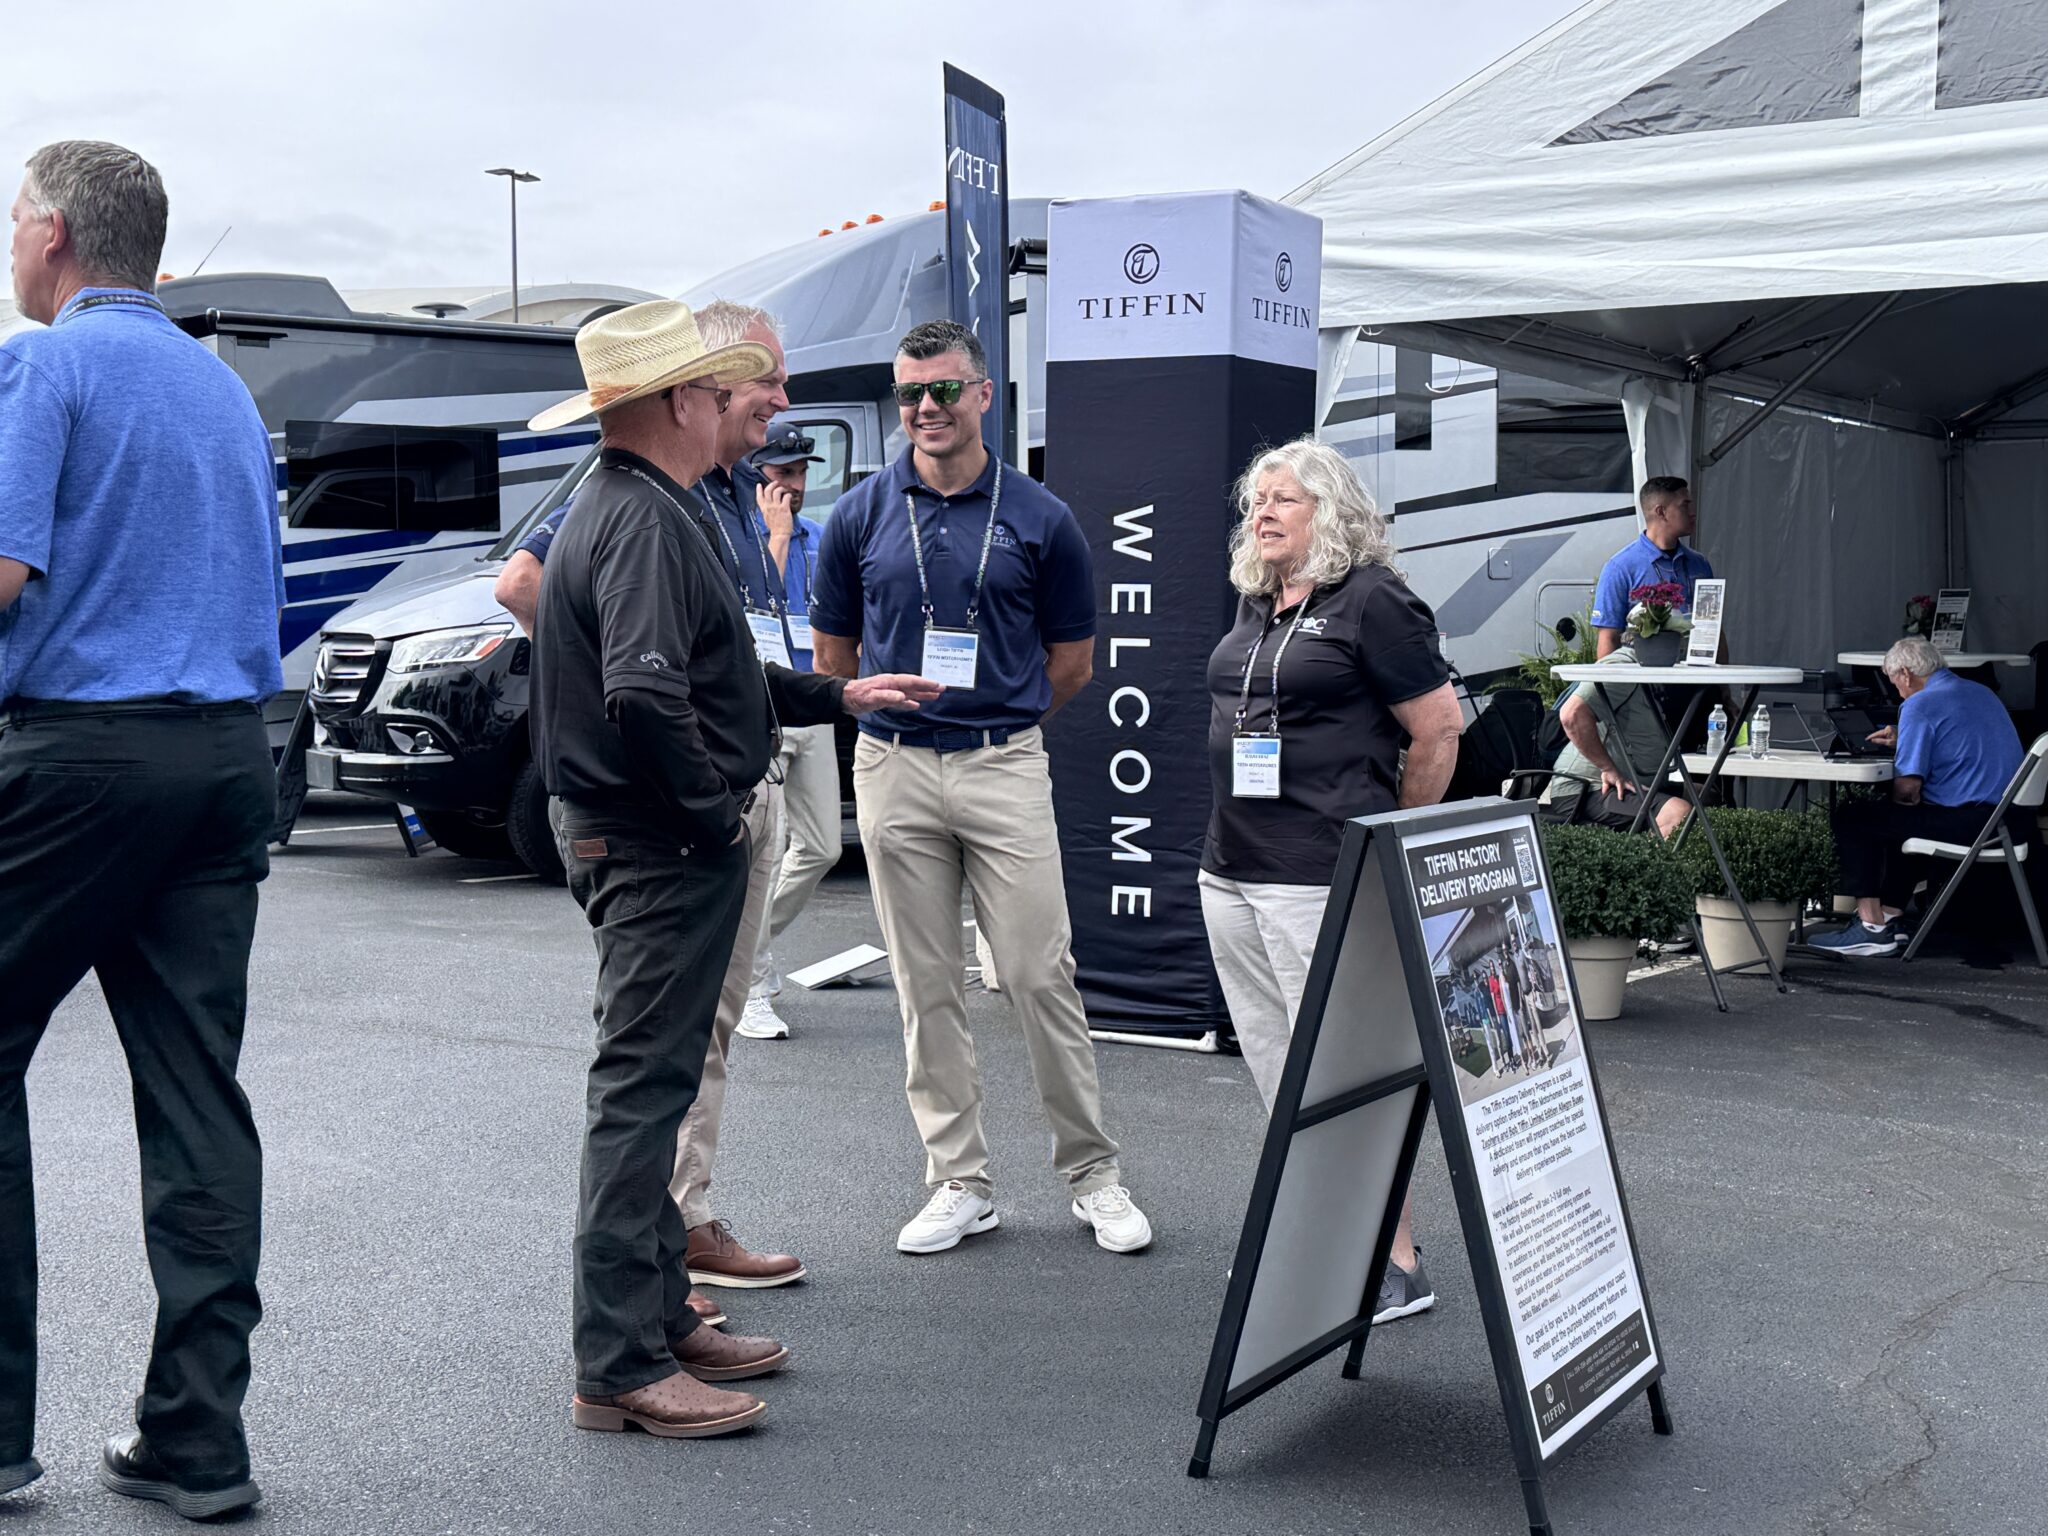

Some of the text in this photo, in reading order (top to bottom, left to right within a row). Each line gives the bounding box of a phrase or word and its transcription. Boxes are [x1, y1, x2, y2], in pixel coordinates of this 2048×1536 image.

[1078, 292, 1206, 319] TIFFIN
[1252, 297, 1311, 329] TIFFIN
[1109, 504, 1154, 918] WELCOME
[1424, 843, 1501, 876] TIFFIN FACTORY
[1420, 866, 1518, 907] DELIVERY PROGRAM
[1542, 1399, 1567, 1426] TIFFIN
